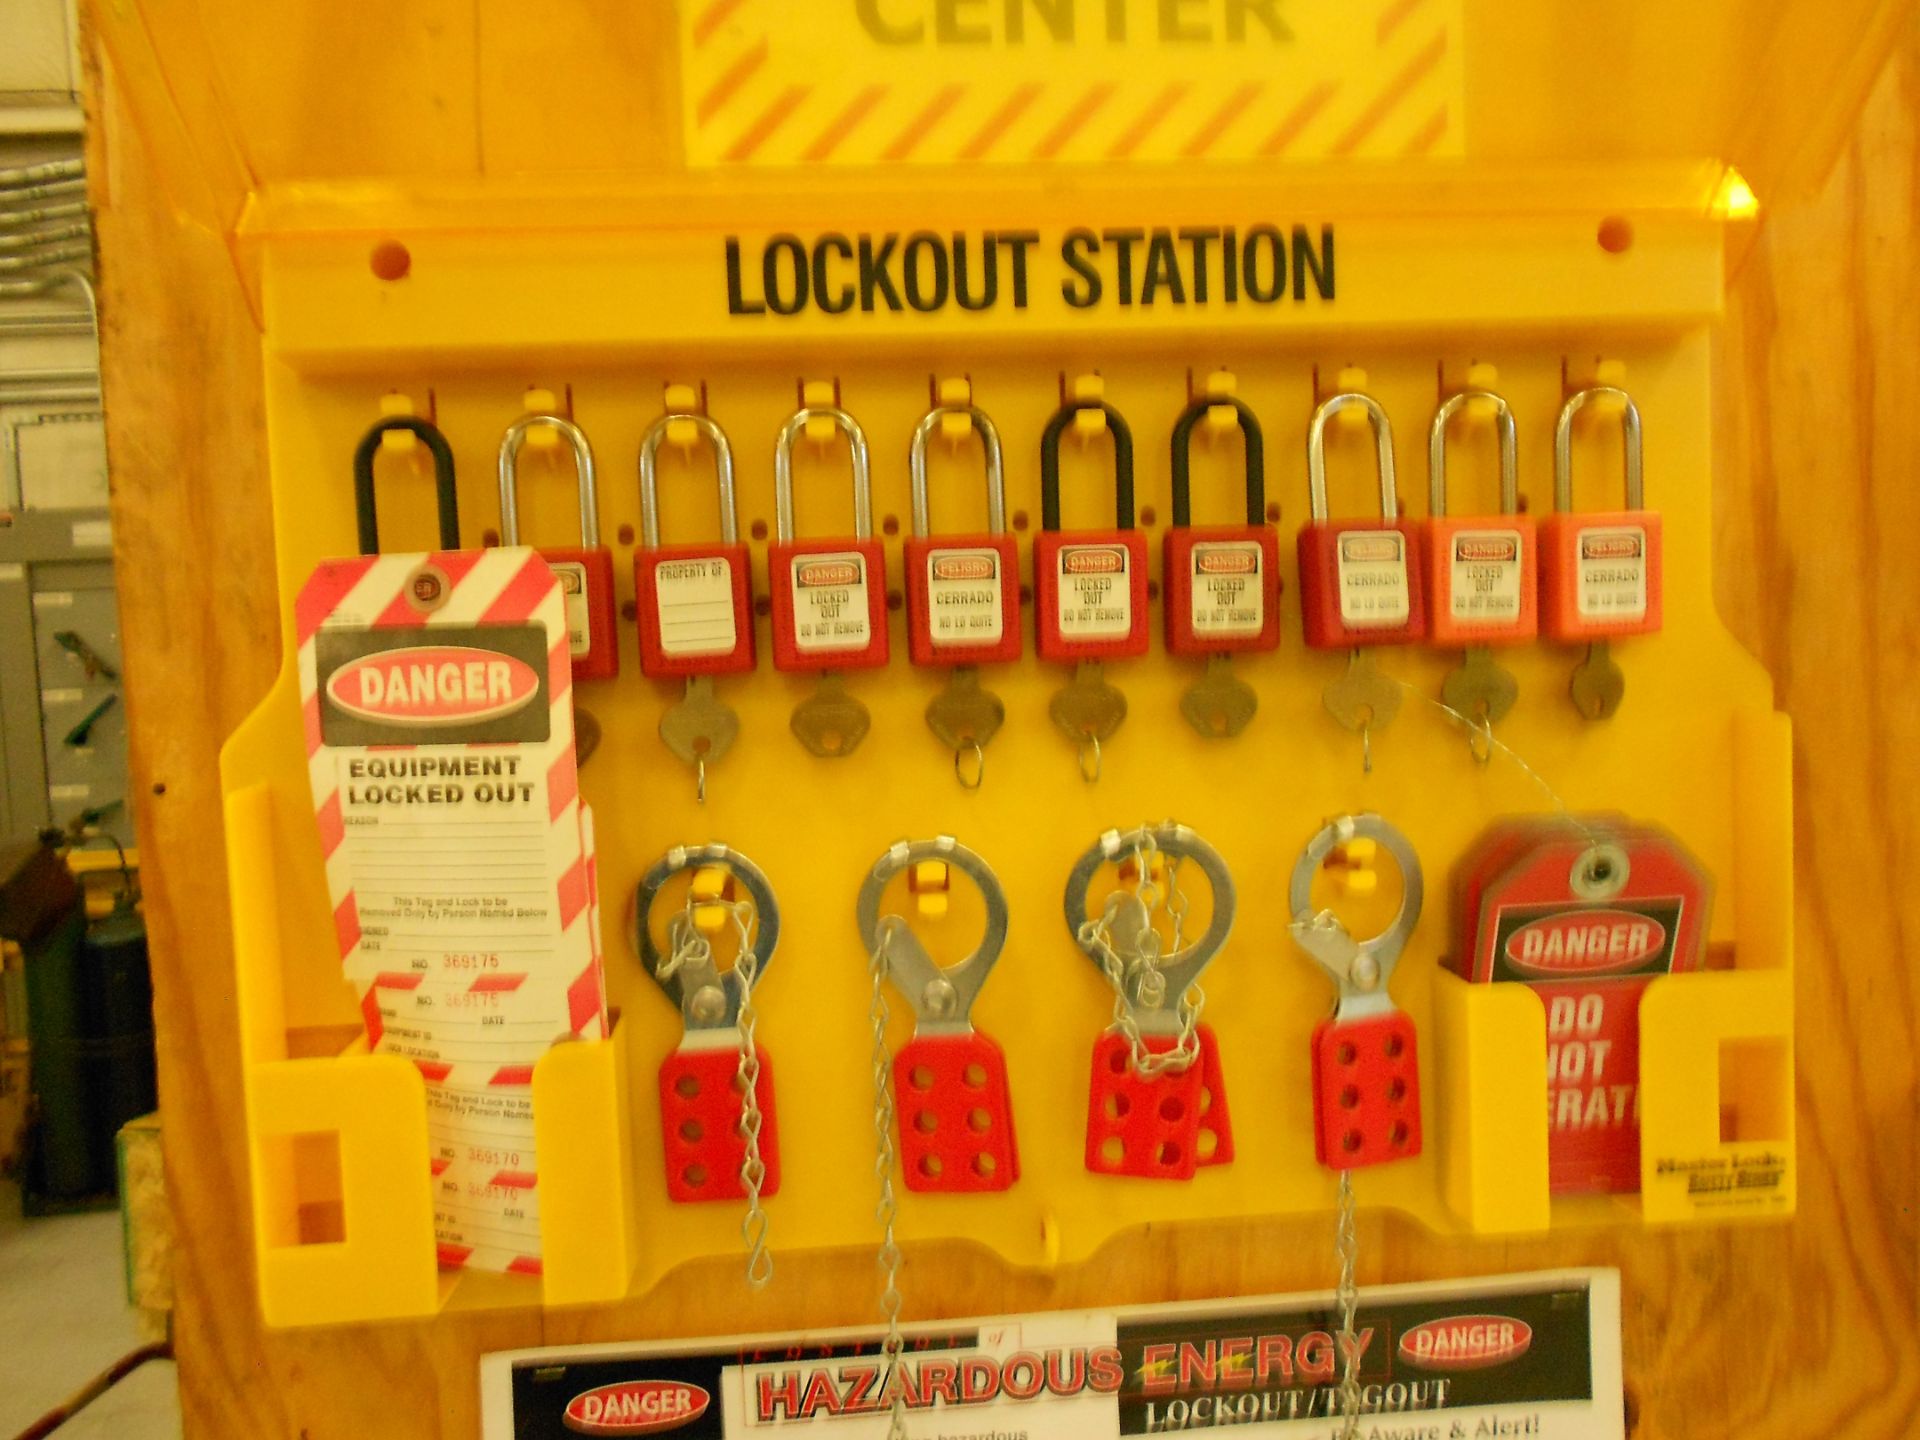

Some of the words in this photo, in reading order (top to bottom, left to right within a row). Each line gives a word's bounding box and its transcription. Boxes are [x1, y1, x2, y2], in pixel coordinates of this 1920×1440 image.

[725, 229, 1040, 316] LOCKOUT
[1060, 222, 1335, 308] STATION
[1070, 555, 1116, 568] DANGER
[1204, 554, 1249, 567] DANGER
[660, 562, 707, 580] PROPERTY
[711, 560, 725, 576] OF
[805, 567, 853, 579] DANGER
[1467, 565, 1503, 578] LOCKED
[1585, 569, 1639, 583] CERRADO
[1074, 578, 1112, 592] LOCKED
[1207, 579, 1245, 592] LOCKED
[1347, 572, 1399, 586] CERRADO
[810, 591, 849, 605] LOCKED
[936, 591, 993, 605] CERRADO
[1084, 591, 1103, 605] OUT
[1217, 591, 1236, 605] OUT
[821, 604, 841, 618] OUT
[939, 615, 953, 628] NO
[955, 615, 967, 628] LO
[359, 661, 513, 706] DANGER
[349, 756, 522, 779] EQUIPMENT
[348, 783, 464, 805] LOCKED
[474, 782, 535, 804] OUT
[392, 896, 413, 906] This
[416, 896, 433, 908] Tag
[436, 896, 454, 906] and
[456, 896, 479, 906] Lock
[495, 896, 508, 906] be
[517, 907, 548, 918] Below
[1522, 923, 1650, 963] DANGER
[443, 954, 499, 969] 369175
[1549, 993, 1605, 1036] DO
[1415, 1323, 1516, 1355] DANGER
[755, 1345, 1124, 1423] HAZARDOUS
[1140, 1326, 1376, 1388] ENERGY
[583, 1388, 693, 1420] DANGER
[1449, 1421, 1466, 1439] &
[1475, 1413, 1540, 1437] Alert!
